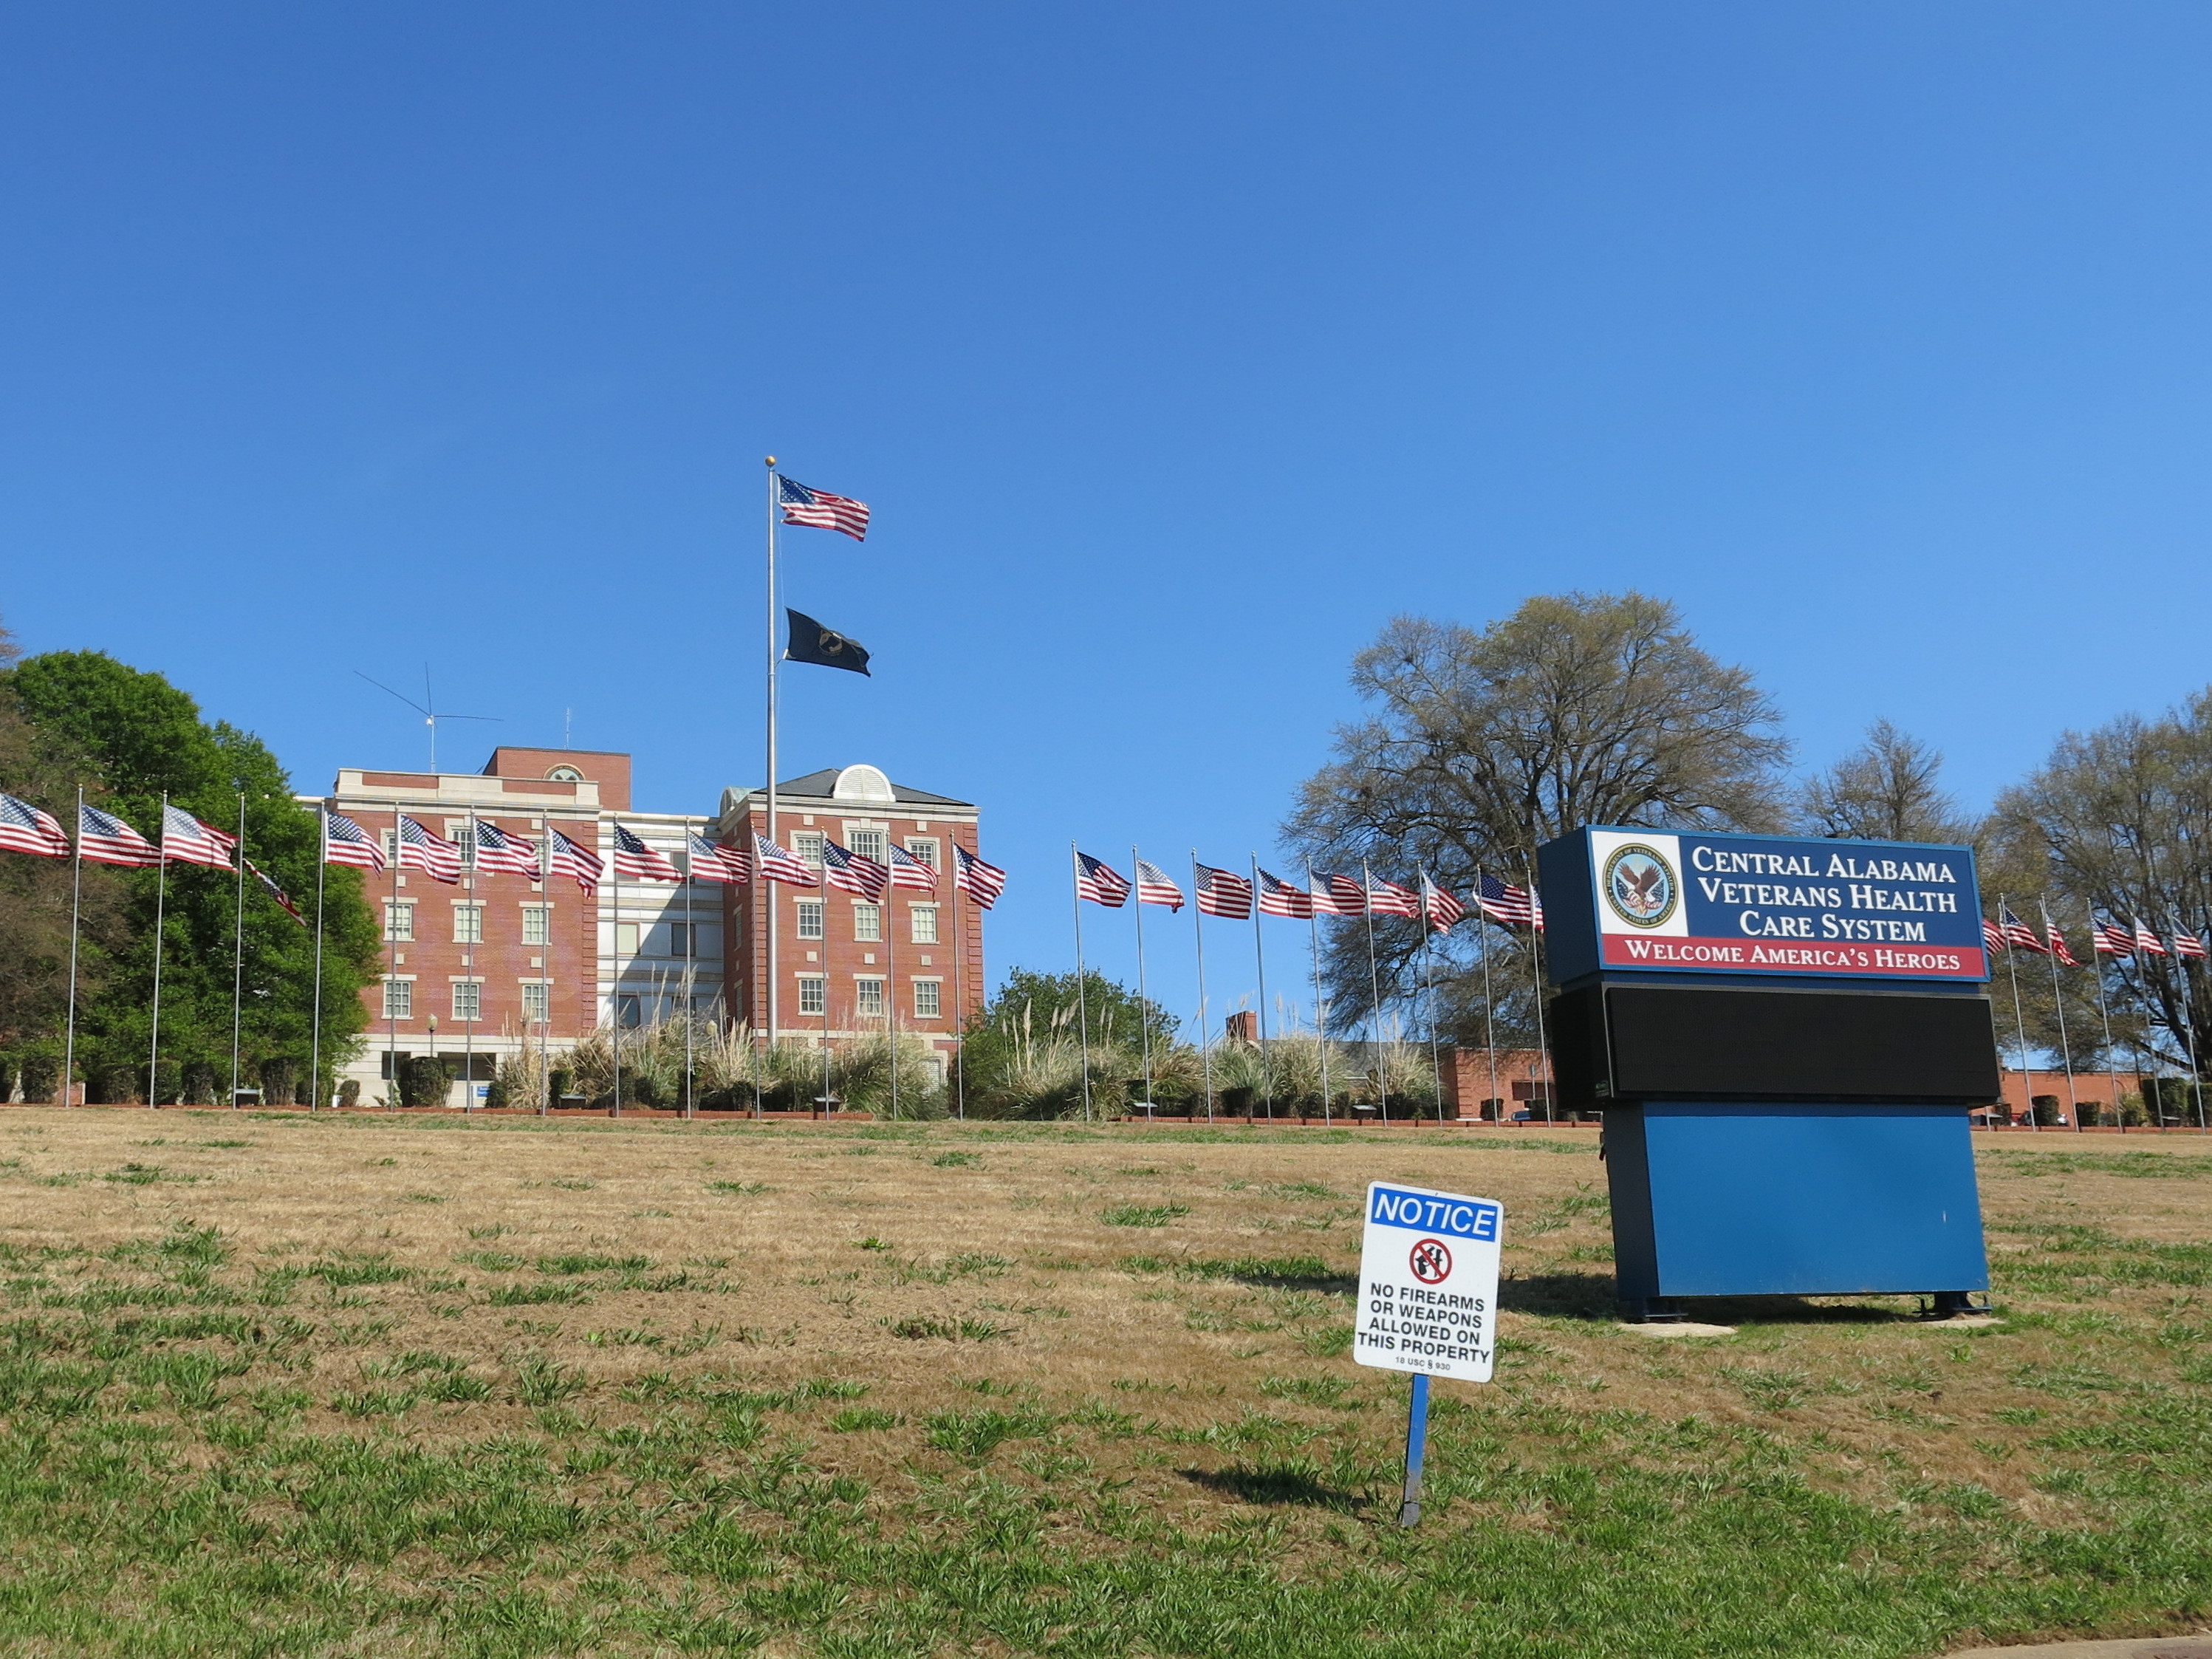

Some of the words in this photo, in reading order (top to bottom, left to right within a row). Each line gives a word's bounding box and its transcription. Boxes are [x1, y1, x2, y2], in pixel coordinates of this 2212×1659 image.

[1691, 846, 1820, 877] CENTRAL
[1826, 853, 1956, 883] ALABAMA
[1697, 877, 1842, 909] VETERANS
[1848, 883, 1957, 913] HEALTH
[1739, 910, 1815, 938] CARE
[1821, 913, 1927, 942] SYSTEM
[1624, 940, 1744, 963] WELCOME
[1750, 945, 1869, 967] AMERICA'S
[1874, 948, 1960, 970] HEROES
[1374, 1193, 1496, 1236] NOTICE
[1370, 1282, 1394, 1298] NO
[1400, 1287, 1485, 1312] FIREARMS
[1370, 1299, 1394, 1316] OR
[1399, 1304, 1482, 1329] WEAPONS
[1369, 1317, 1451, 1341] ALLOWED
[1456, 1330, 1480, 1346] ON
[1357, 1332, 1395, 1350] THIS
[1401, 1338, 1490, 1364] PROPERTY
[1395, 1356, 1405, 1364] 18
[1408, 1358, 1425, 1366] USC
[1435, 1362, 1451, 1371] 930
